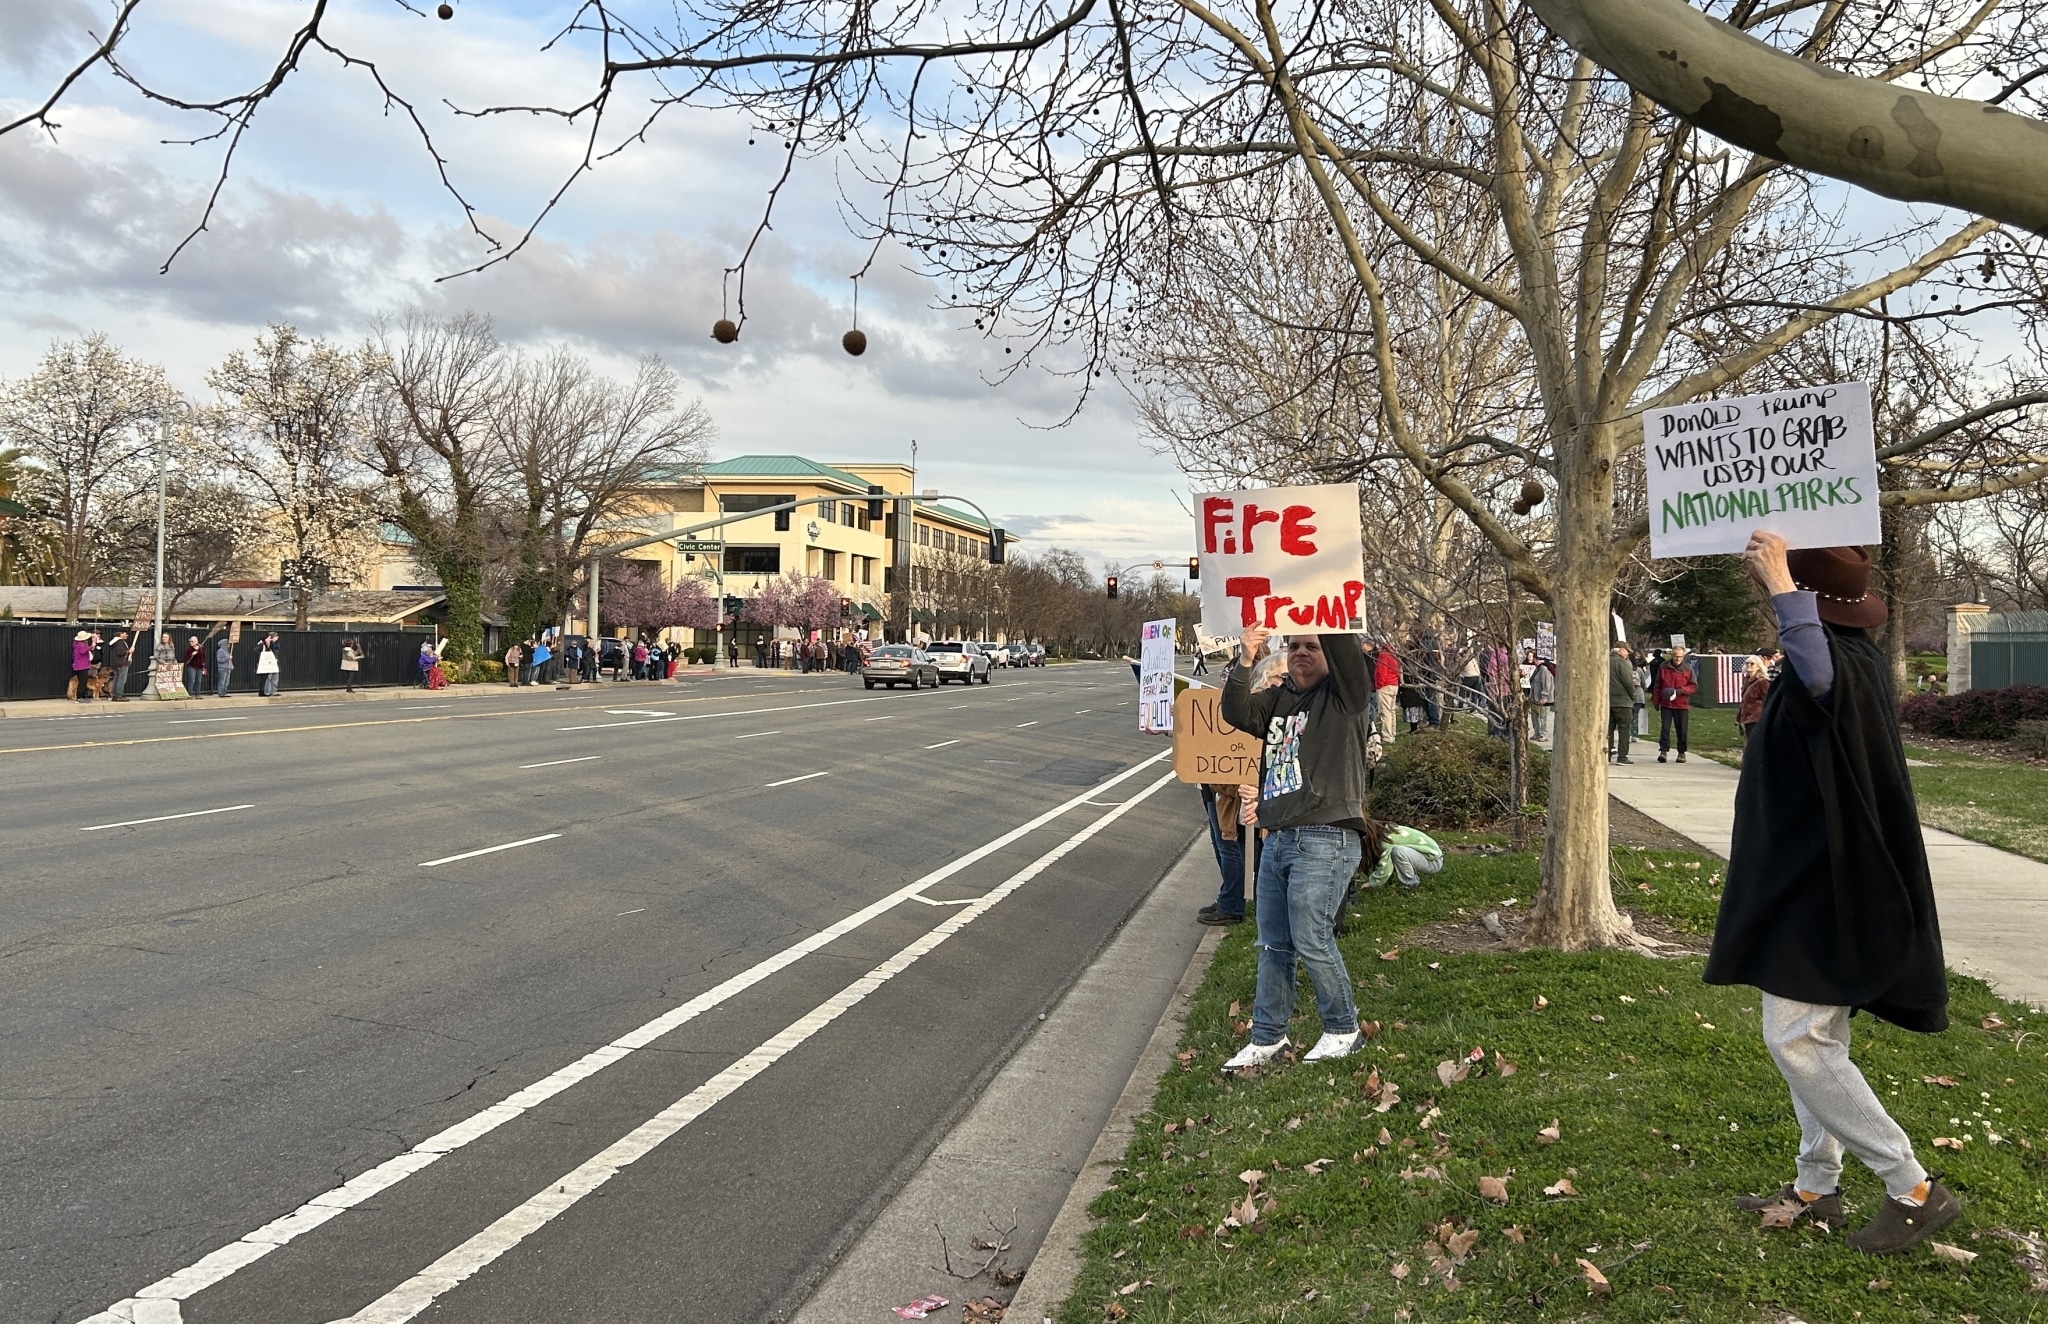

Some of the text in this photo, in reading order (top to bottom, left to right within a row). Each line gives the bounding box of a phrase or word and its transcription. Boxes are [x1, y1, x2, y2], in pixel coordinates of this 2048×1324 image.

[1655, 431, 1741, 471] WANTS
[1743, 427, 1776, 454] TO
[1783, 414, 1848, 448] GRAB
[1704, 447, 1836, 488] US BY OUR
[1662, 476, 1863, 534] NATIONAL PARKS
[698, 543, 721, 551] Center
[1143, 624, 1172, 640] MEN OF
[1143, 646, 1171, 672] Quality
[1140, 699, 1173, 729] EQUALITY
[1230, 743, 1245, 752] OR
[1196, 755, 1262, 776] DICTA
